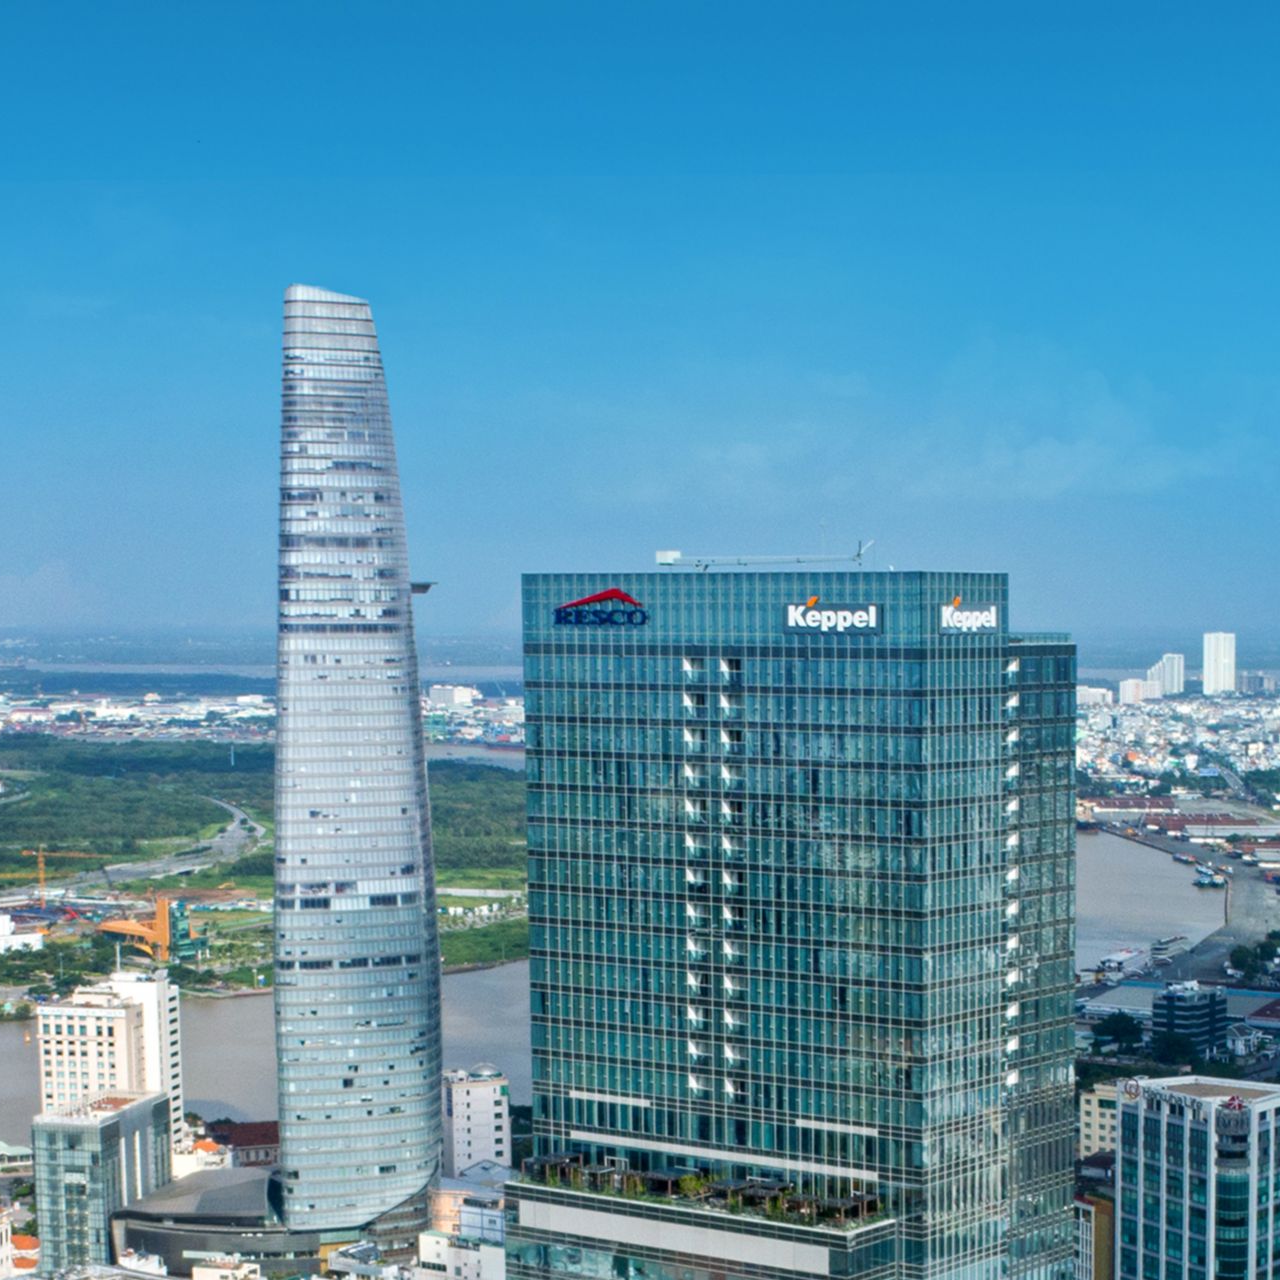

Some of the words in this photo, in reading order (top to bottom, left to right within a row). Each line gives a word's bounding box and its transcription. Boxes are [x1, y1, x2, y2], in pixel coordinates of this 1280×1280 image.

[554, 608, 647, 625] RESCO
[787, 605, 877, 631] Keppel
[941, 605, 997, 632] Keppel
